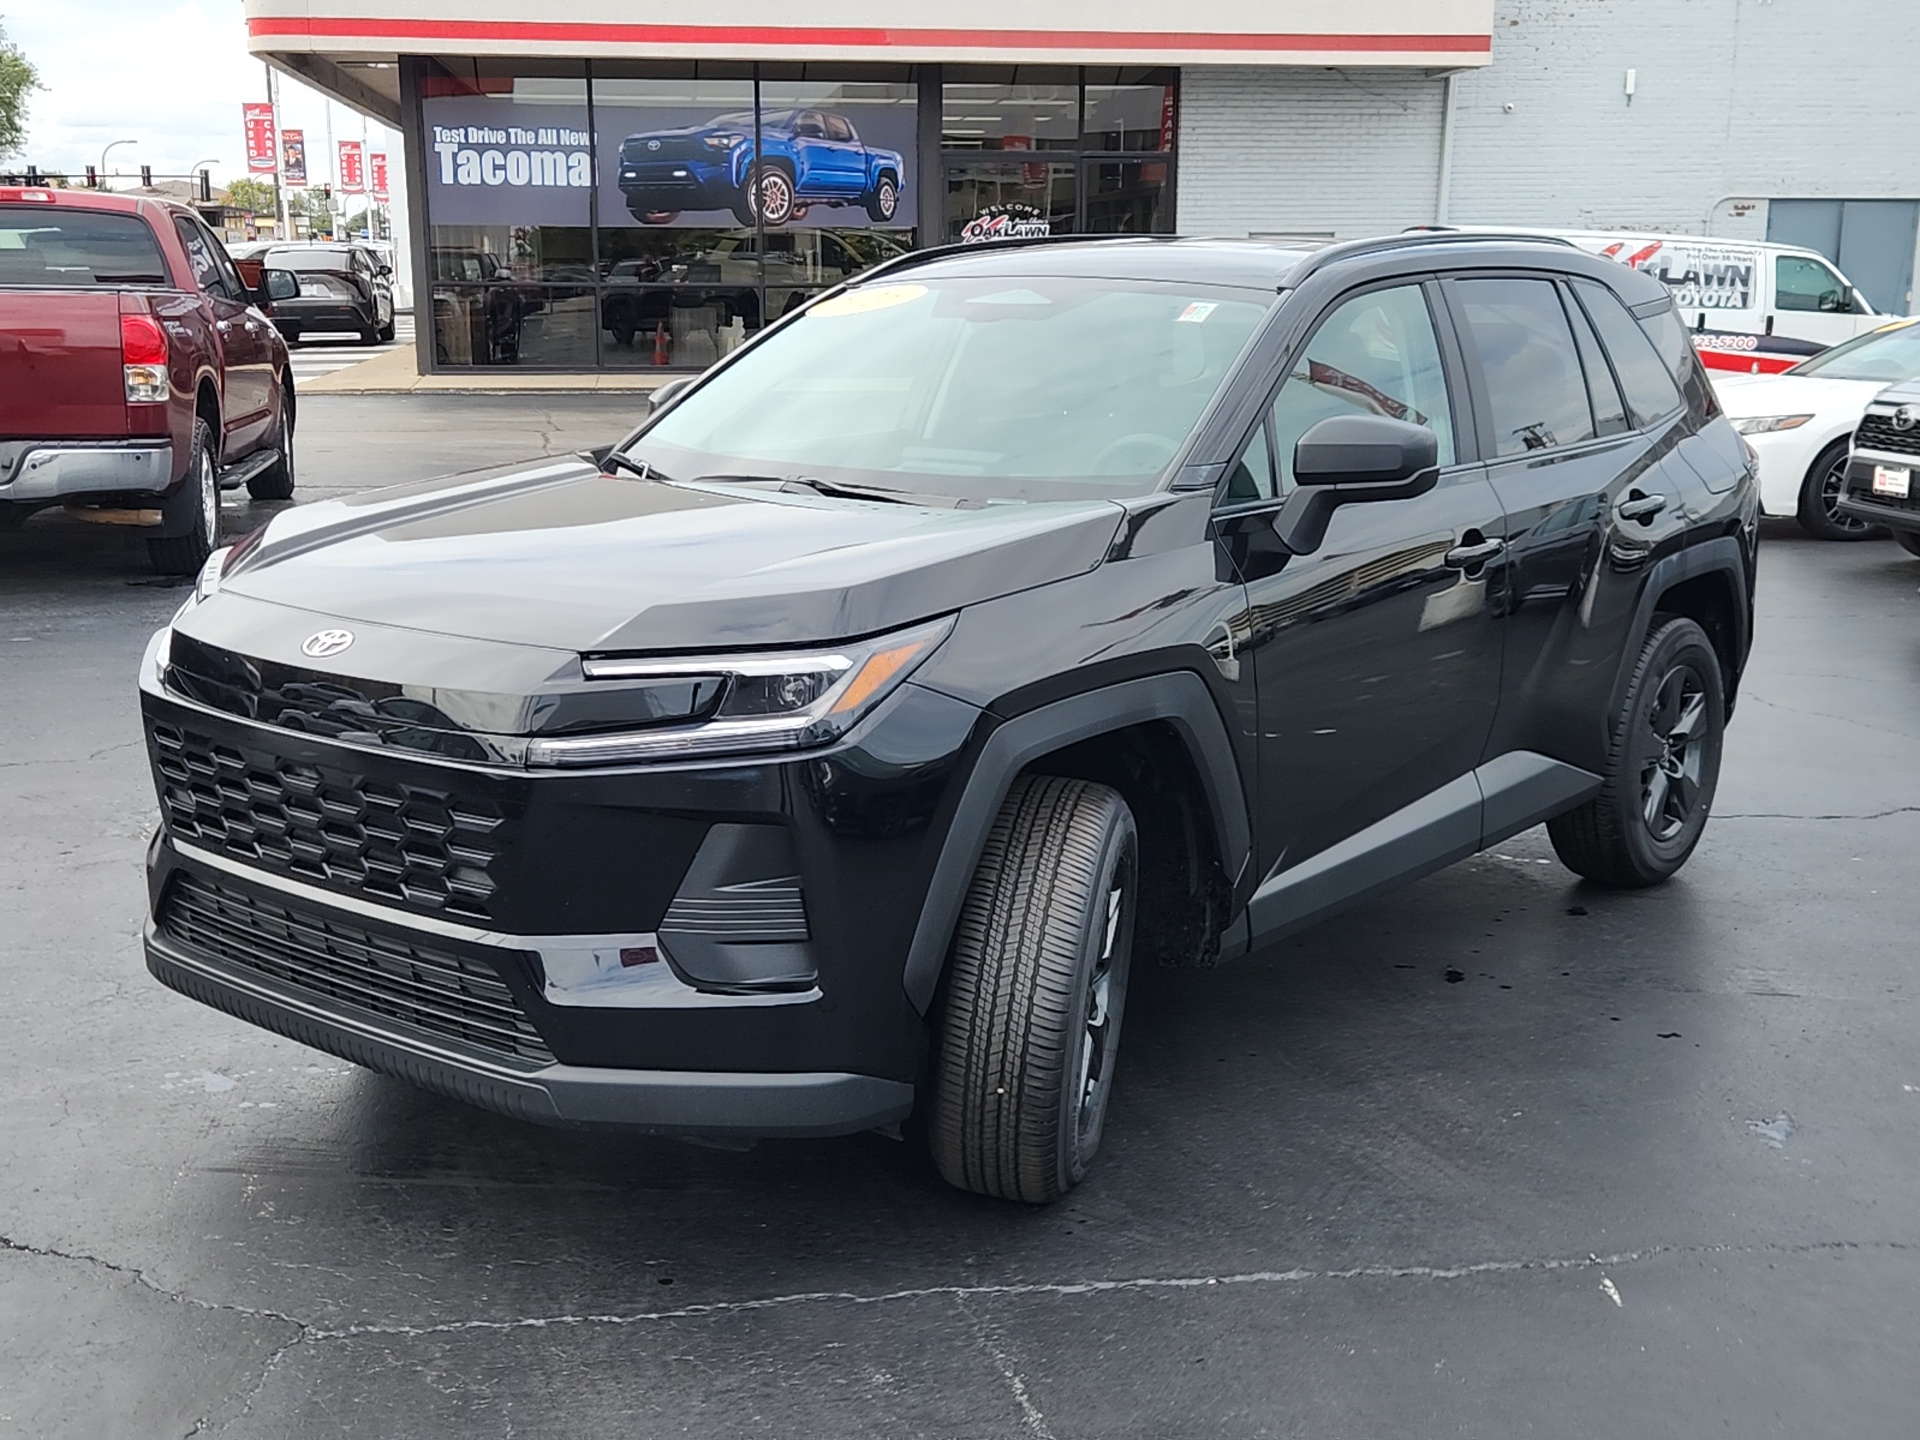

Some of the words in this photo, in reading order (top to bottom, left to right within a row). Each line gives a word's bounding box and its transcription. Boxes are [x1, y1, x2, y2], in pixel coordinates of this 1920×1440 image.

[247, 121, 257, 157] USED
[264, 121, 273, 157] CARS
[433, 126, 466, 143] Test
[467, 127, 506, 144] Drive
[508, 128, 535, 145] The
[537, 128, 557, 145] All
[559, 129, 597, 146] New
[434, 143, 599, 187] Tacoma
[979, 203, 1041, 215] WELCOME
[1719, 247, 1762, 256] Community
[1694, 337, 1756, 349] 23-5200
